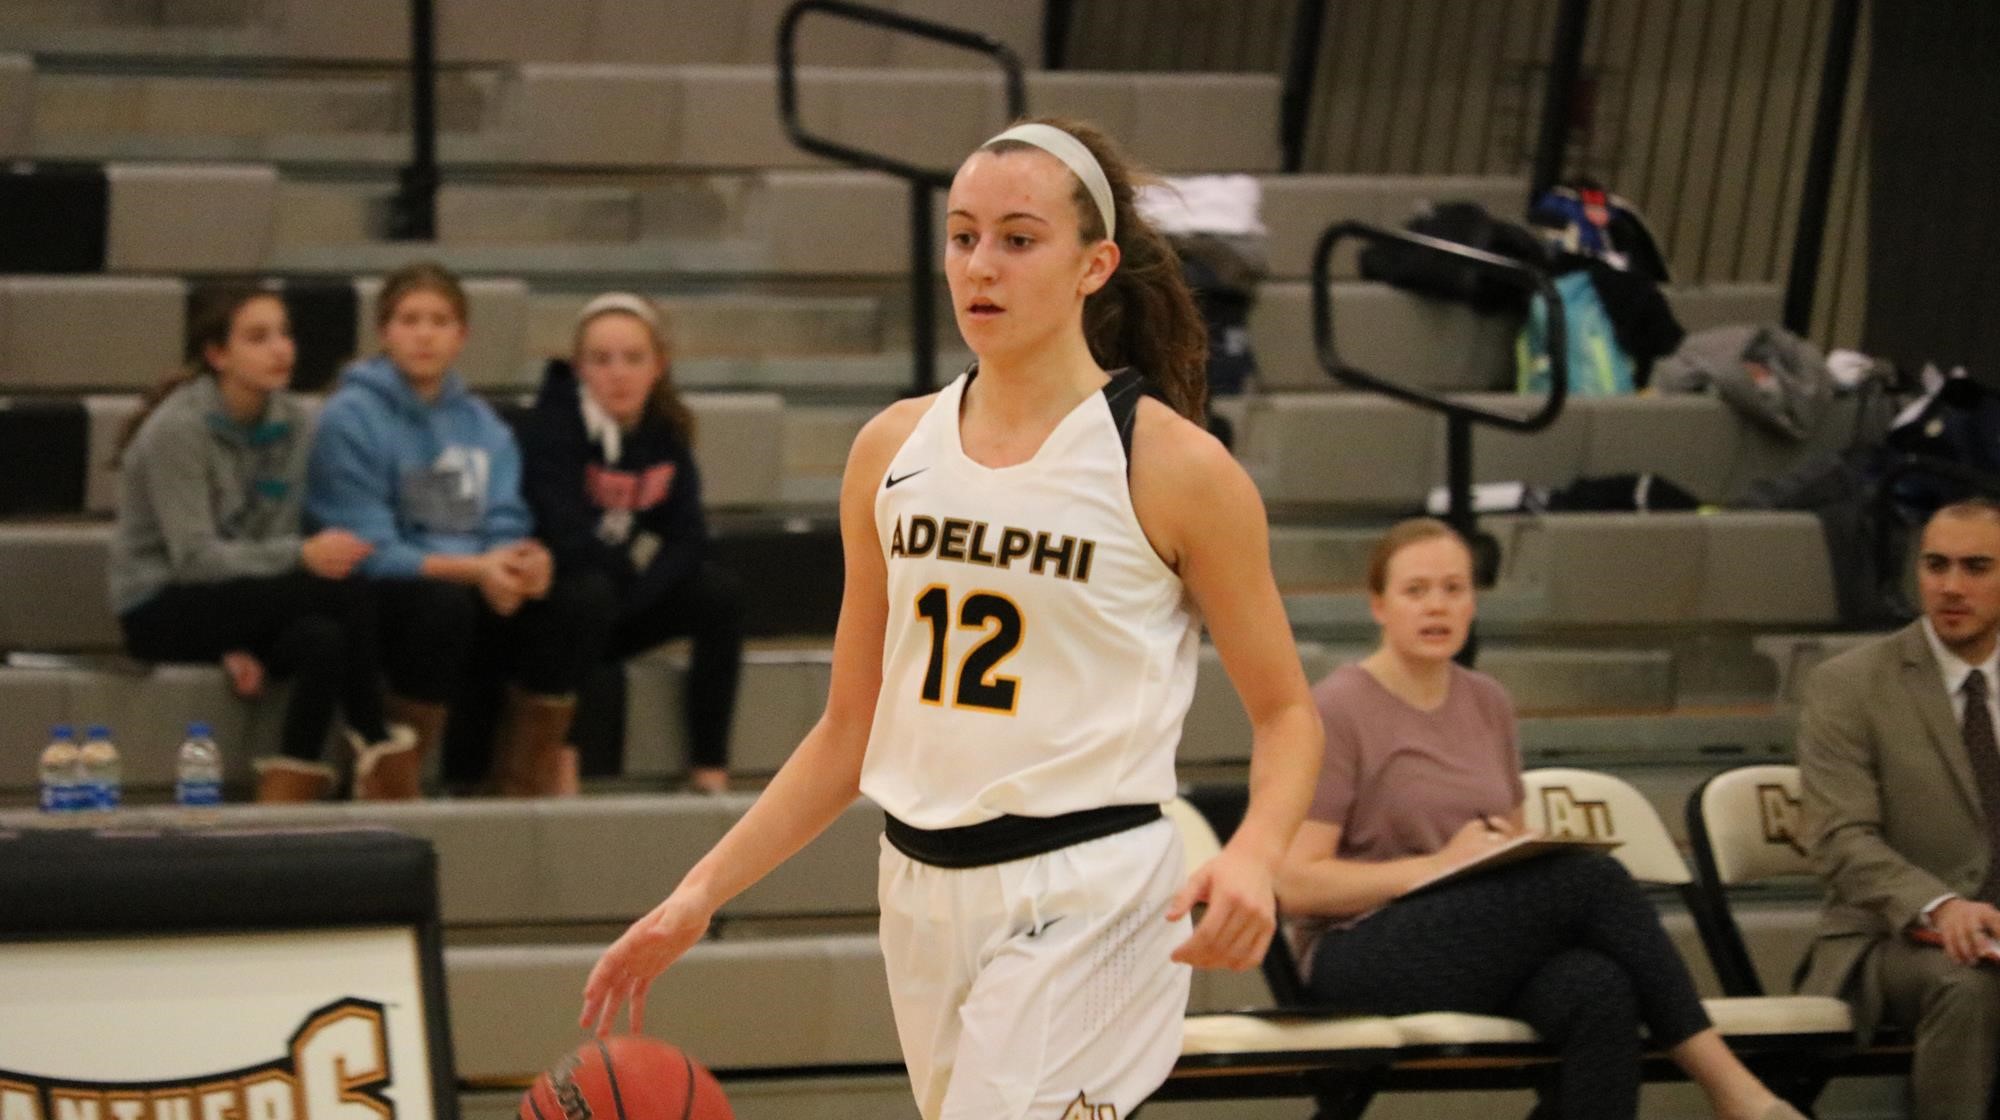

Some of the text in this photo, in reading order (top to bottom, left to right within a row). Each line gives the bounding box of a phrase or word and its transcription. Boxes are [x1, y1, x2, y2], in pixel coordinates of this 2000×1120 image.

[890, 512, 1096, 584] ADELPHI
[914, 582, 1026, 716] 12
[1756, 784, 1808, 856] A
